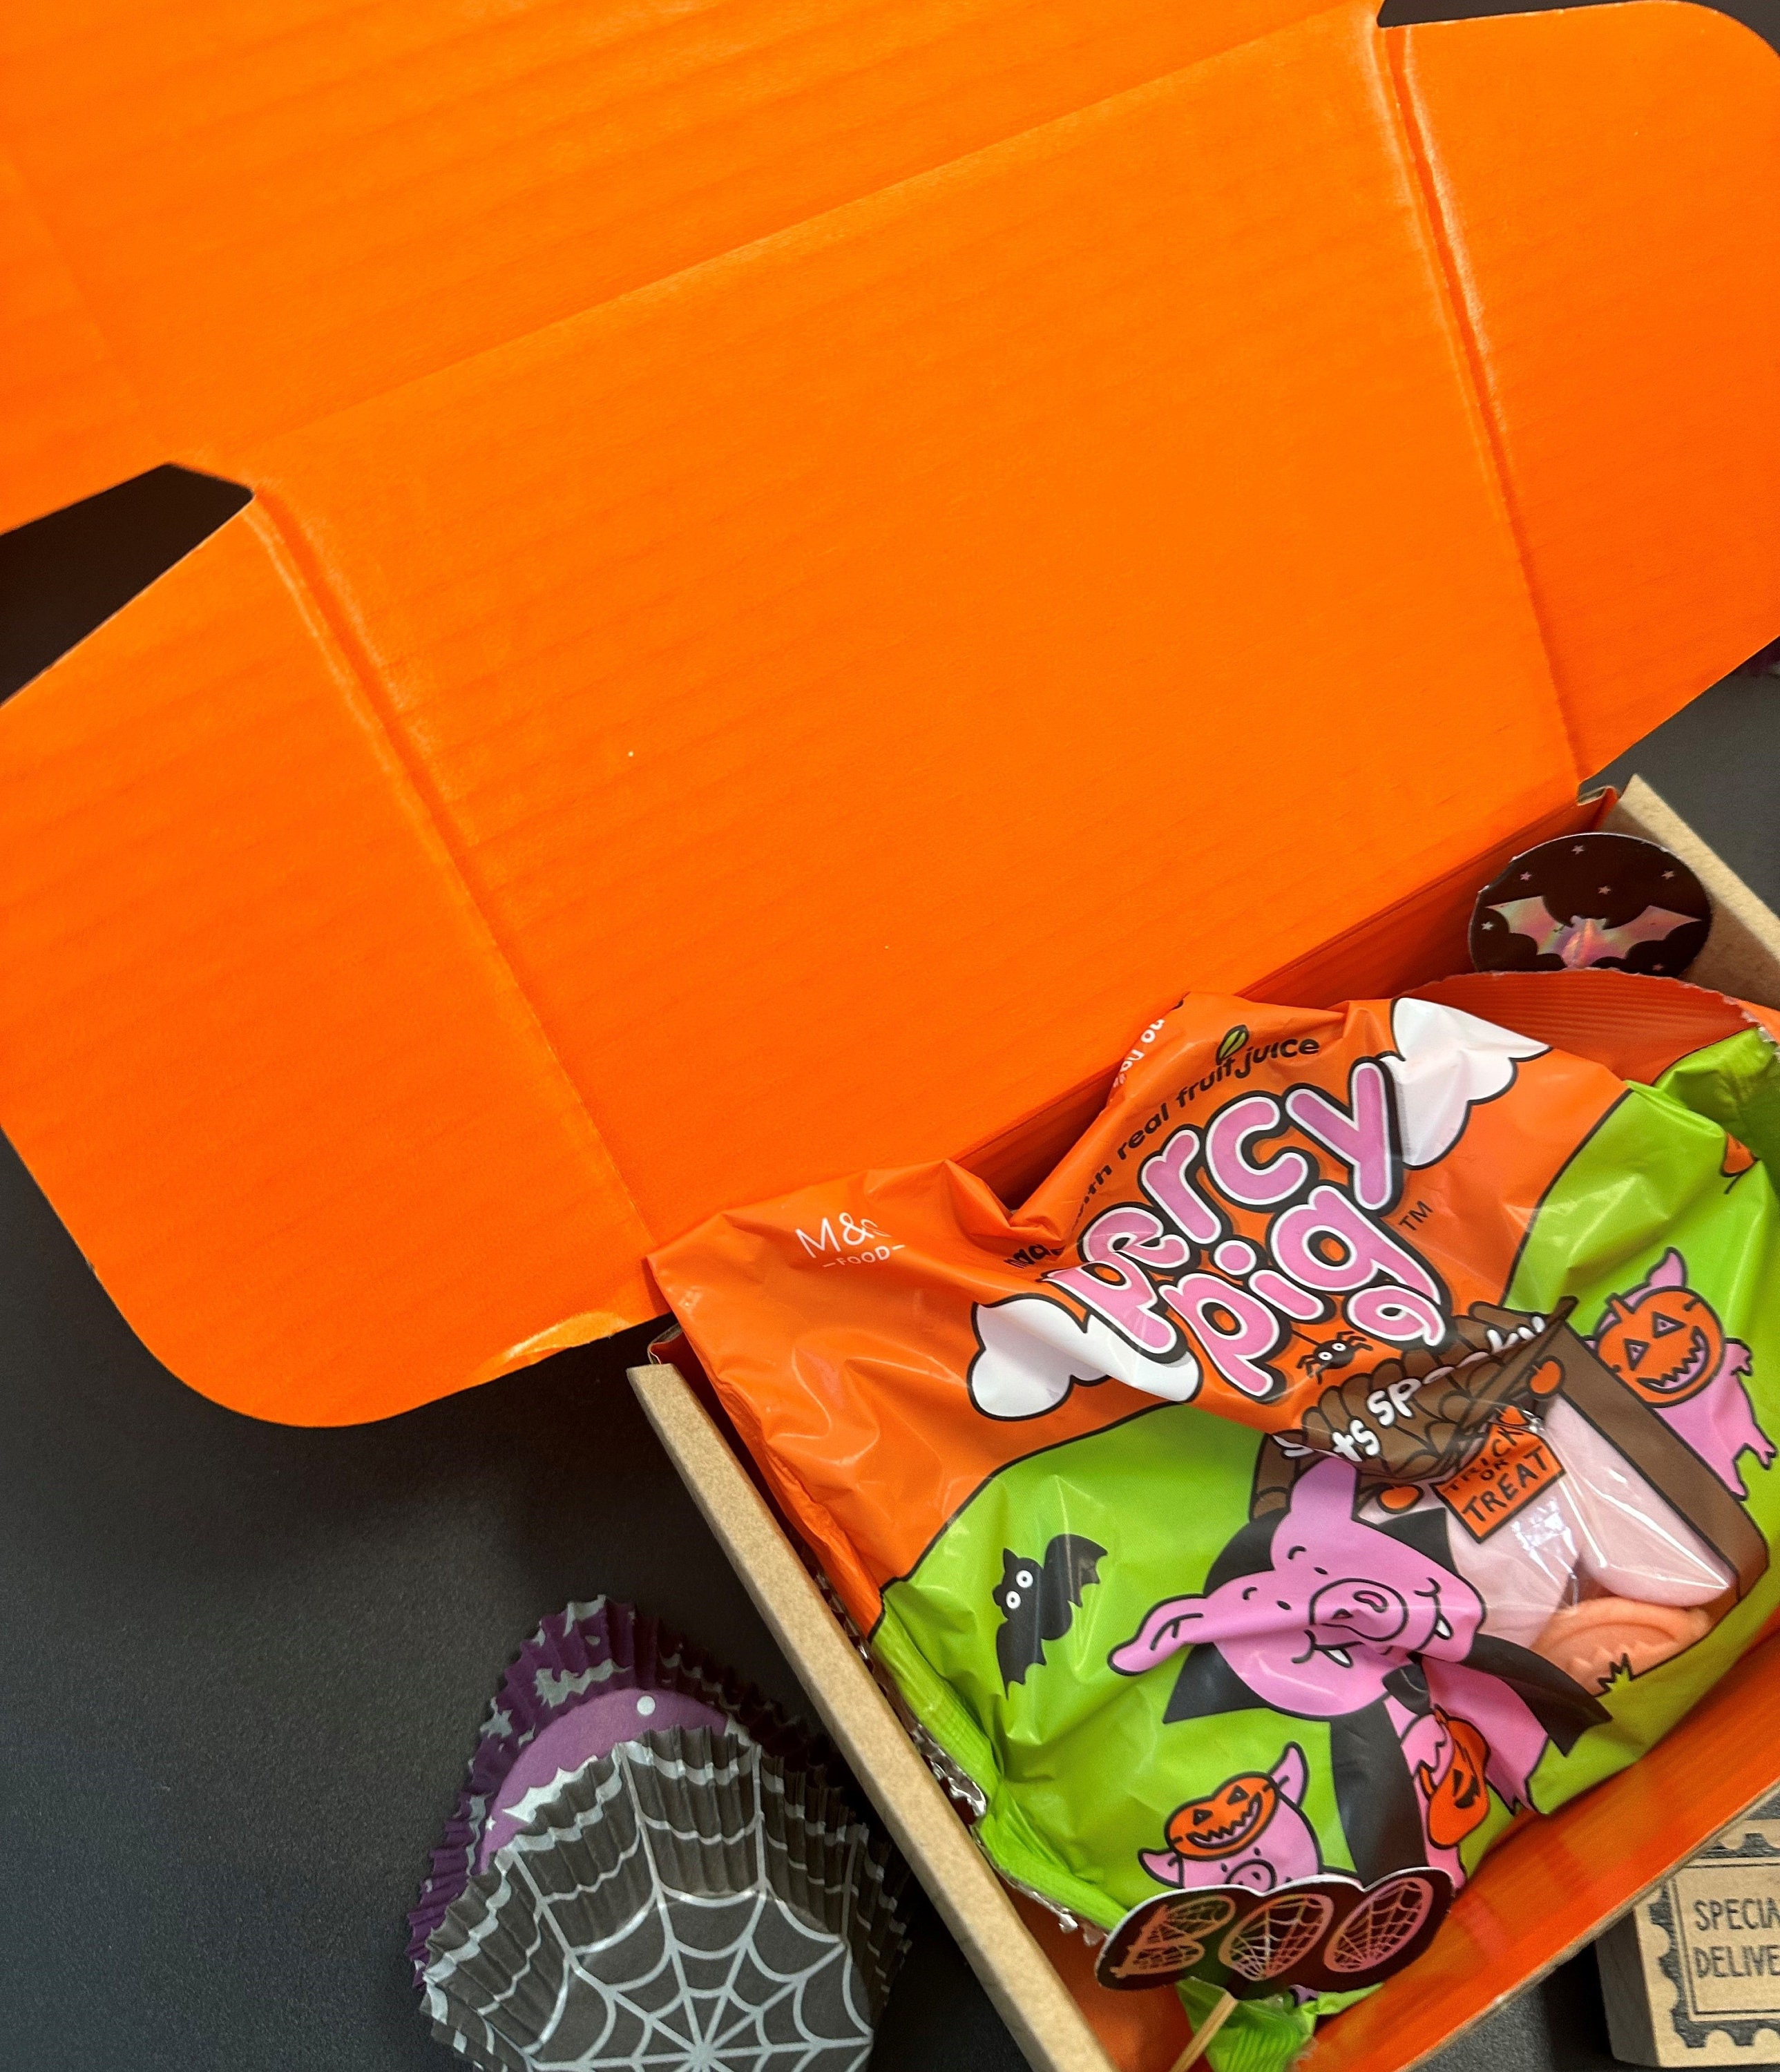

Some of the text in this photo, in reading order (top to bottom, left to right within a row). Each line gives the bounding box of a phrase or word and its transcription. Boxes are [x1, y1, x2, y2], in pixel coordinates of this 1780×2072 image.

[1117, 1102, 1169, 1160] real
[1176, 1057, 1235, 1109] fruit
[1234, 1038, 1320, 1078] juice
[1040, 1059, 1395, 1357] percy
[1154, 1182, 1447, 1399] pig TM
[1462, 1446, 1548, 1522] TREAT
